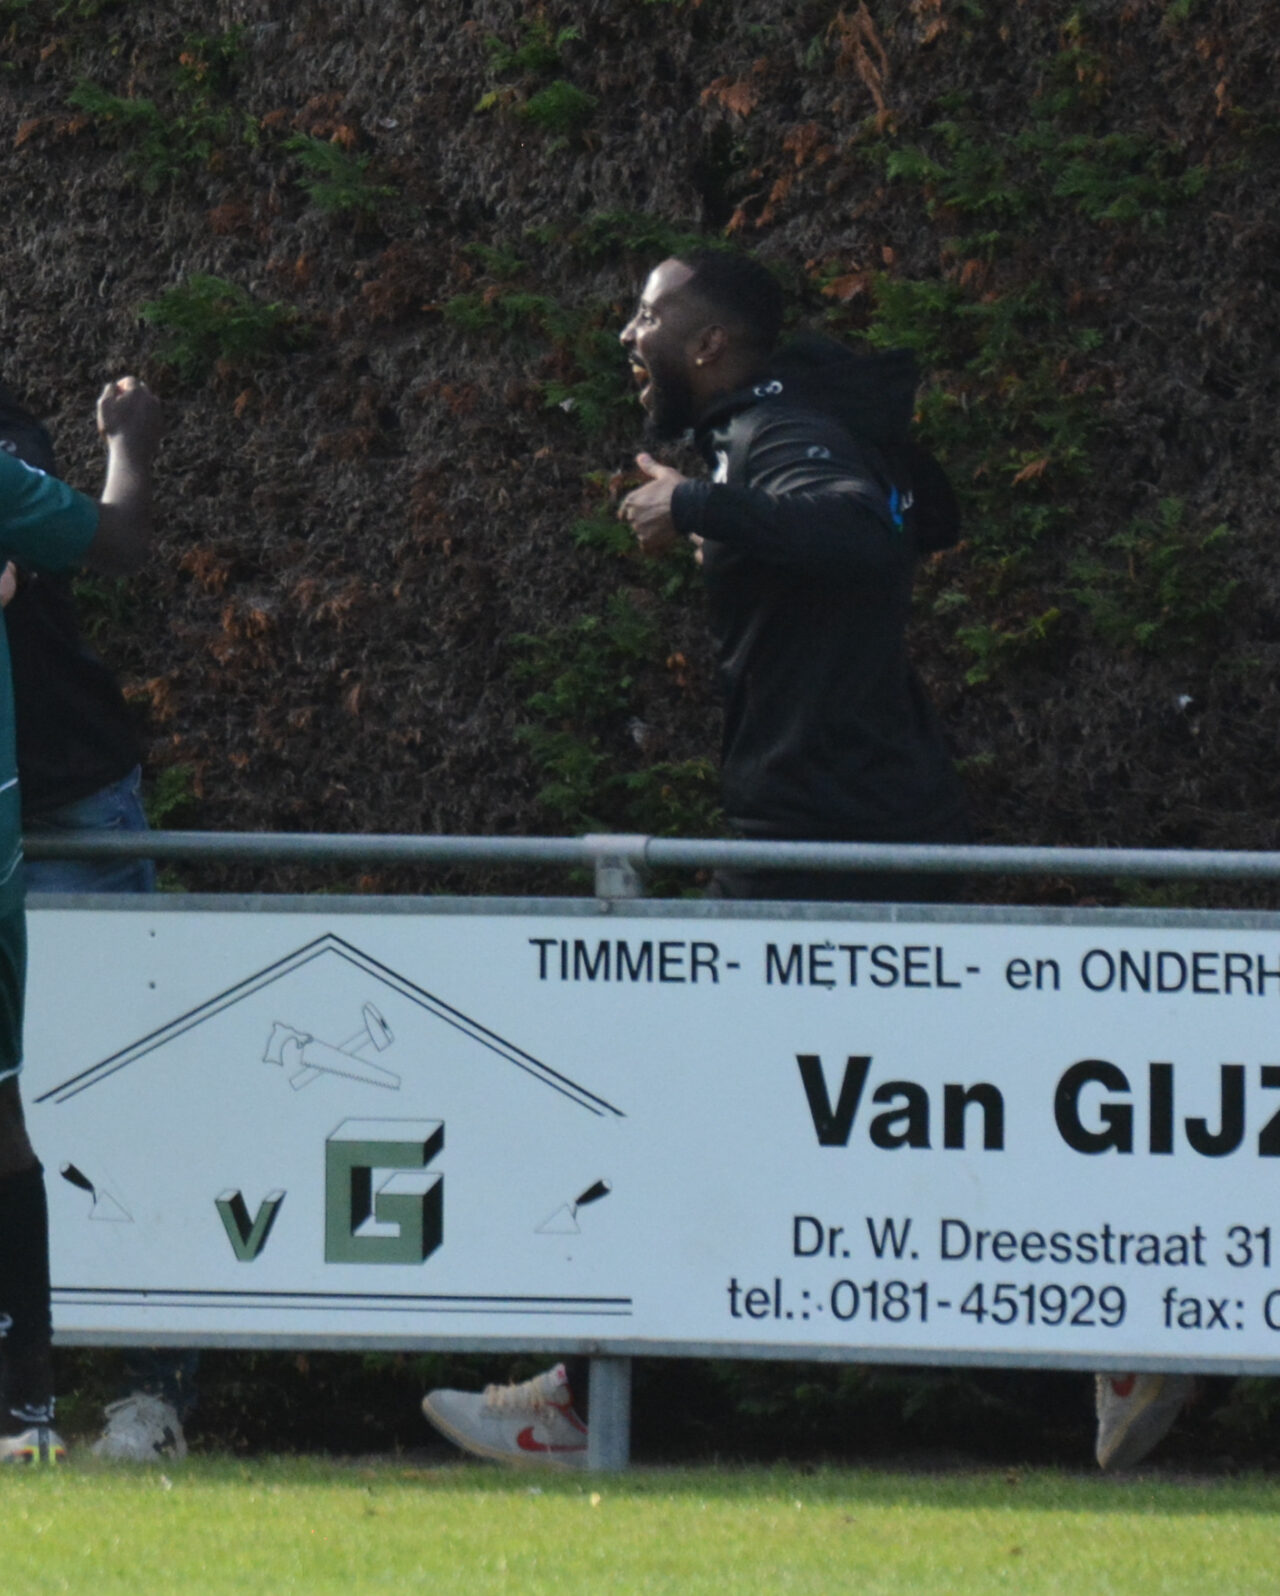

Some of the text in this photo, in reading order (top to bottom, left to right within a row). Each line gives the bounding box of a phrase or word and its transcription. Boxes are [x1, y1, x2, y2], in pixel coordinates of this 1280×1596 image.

[529, 939, 741, 983] TIMMER-
[766, 943, 981, 990] METSEL-
[1006, 956, 1061, 991] en
[795, 1054, 1005, 1150] Van
[793, 1215, 1271, 1268] Dr. W. Dreesstraat 31
[830, 1279, 1127, 1328] 0181-451929
[1163, 1286, 1245, 1330] fax:
